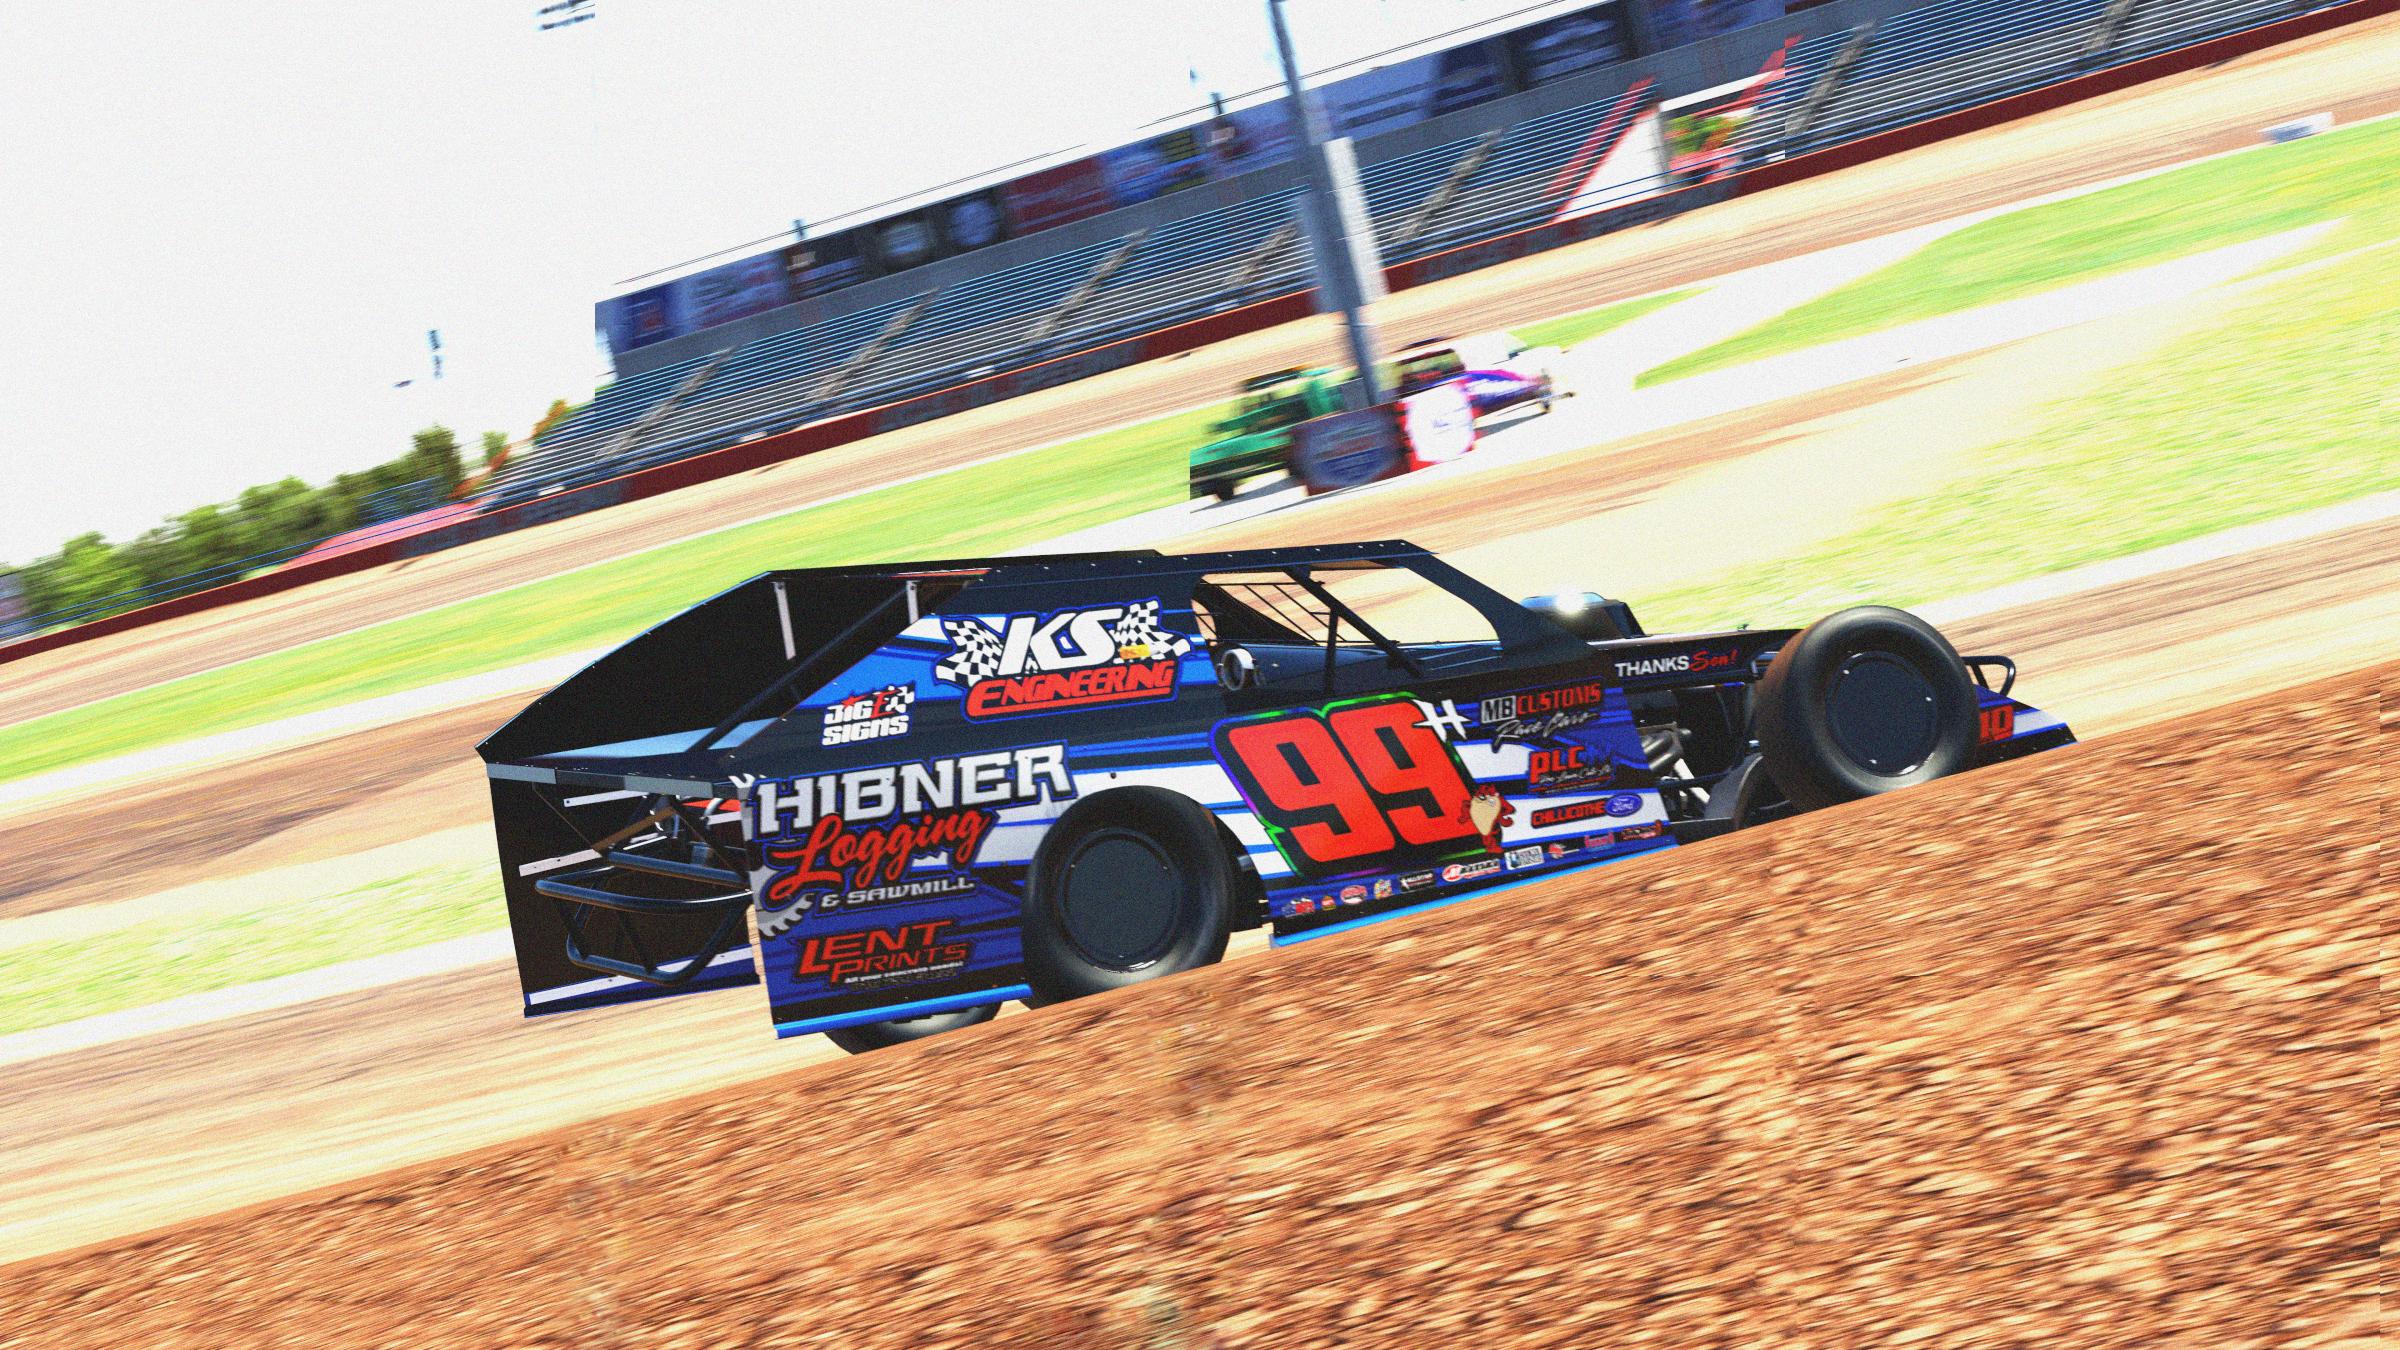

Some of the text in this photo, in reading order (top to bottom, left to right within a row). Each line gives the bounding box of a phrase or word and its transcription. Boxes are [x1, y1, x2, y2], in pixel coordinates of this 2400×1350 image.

[997, 607, 1123, 675] KS
[967, 660, 1175, 718] ENGINEERING
[1615, 655, 1689, 678] THANKS
[1484, 683, 1601, 722] MB CUSTOMS
[1530, 746, 1586, 785] PLC
[757, 745, 1073, 835] HIBNER
[770, 810, 991, 901] Logging
[821, 877, 976, 909] & SAWMILL
[800, 920, 952, 974] LENT
[831, 942, 970, 984] PRINTS
